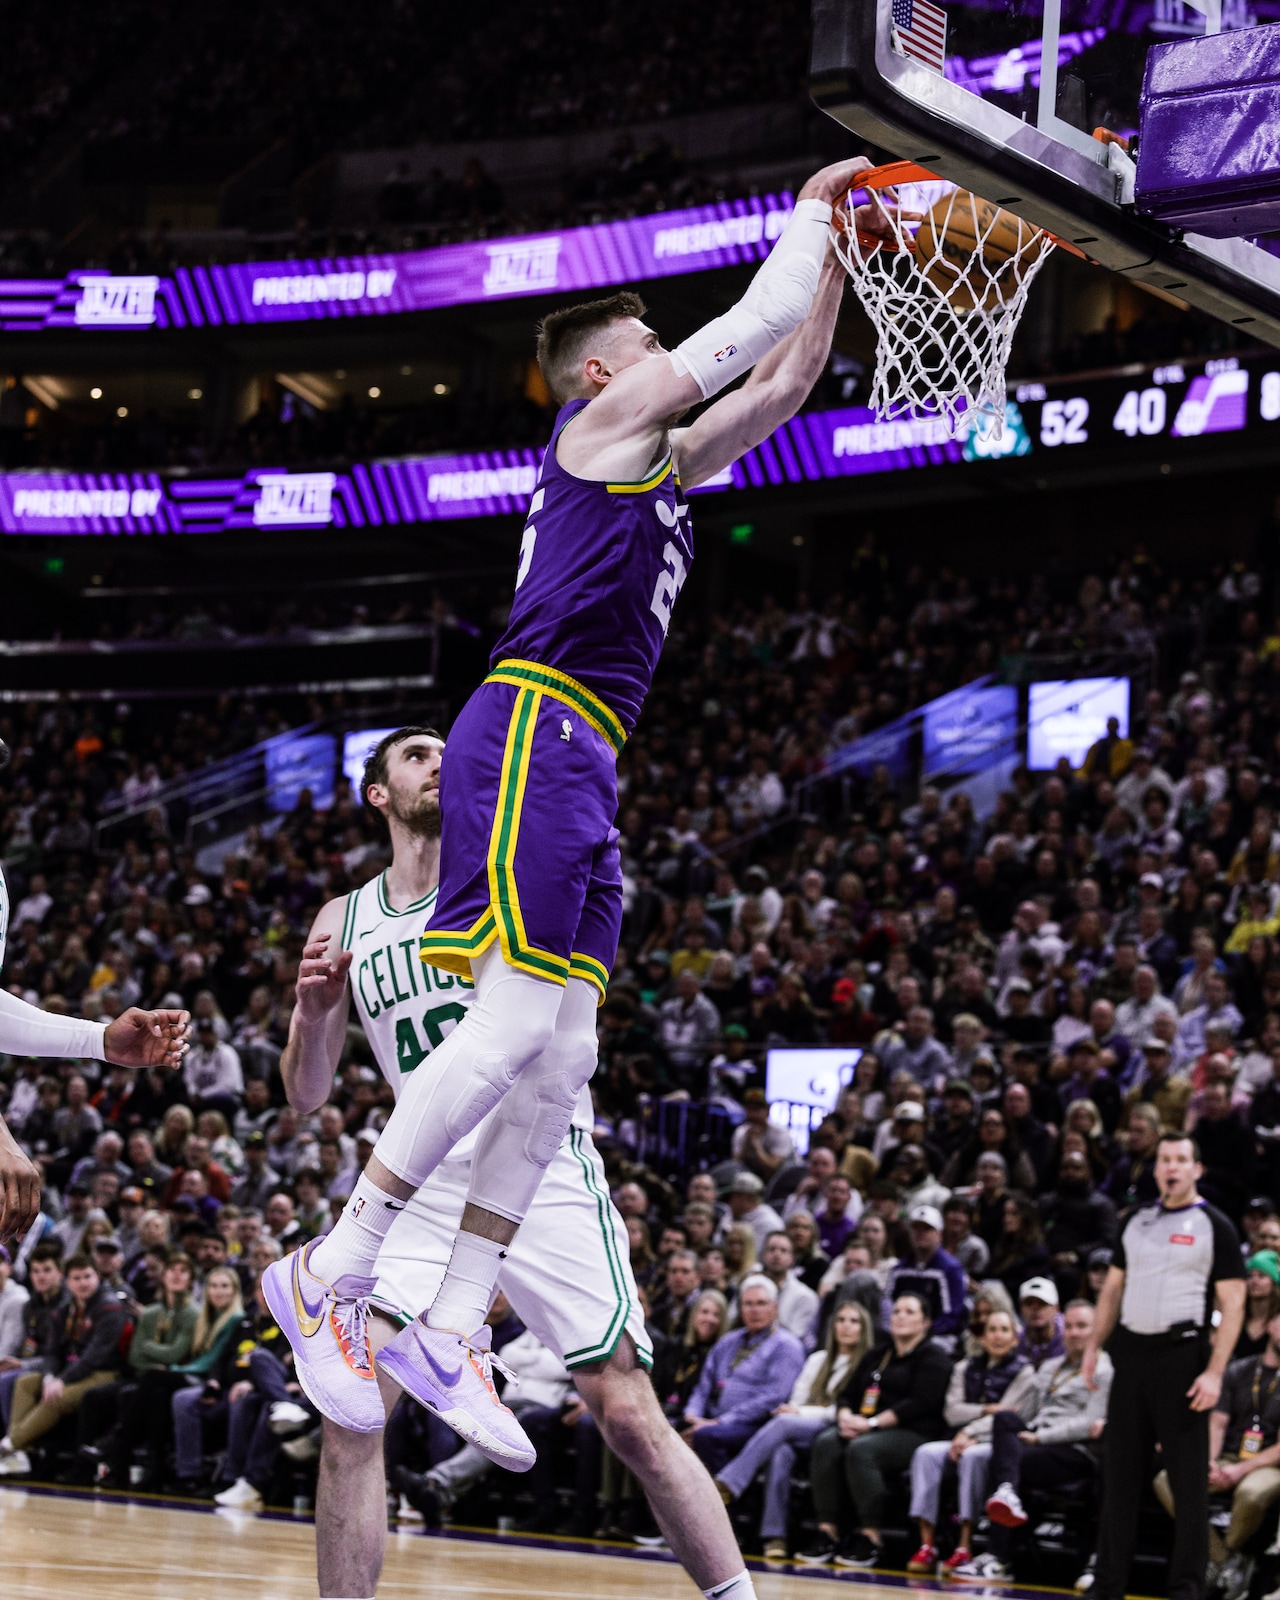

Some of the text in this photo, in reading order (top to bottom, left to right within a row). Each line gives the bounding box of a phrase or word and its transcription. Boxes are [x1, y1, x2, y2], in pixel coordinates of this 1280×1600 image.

[653, 214, 764, 259] PRESENTED
[252, 268, 397, 306] PRESENTED BY
[1040, 387, 1167, 447] 52 40
[13, 487, 162, 518] PRESENTED BY
[427, 464, 537, 503] PRESENTED
